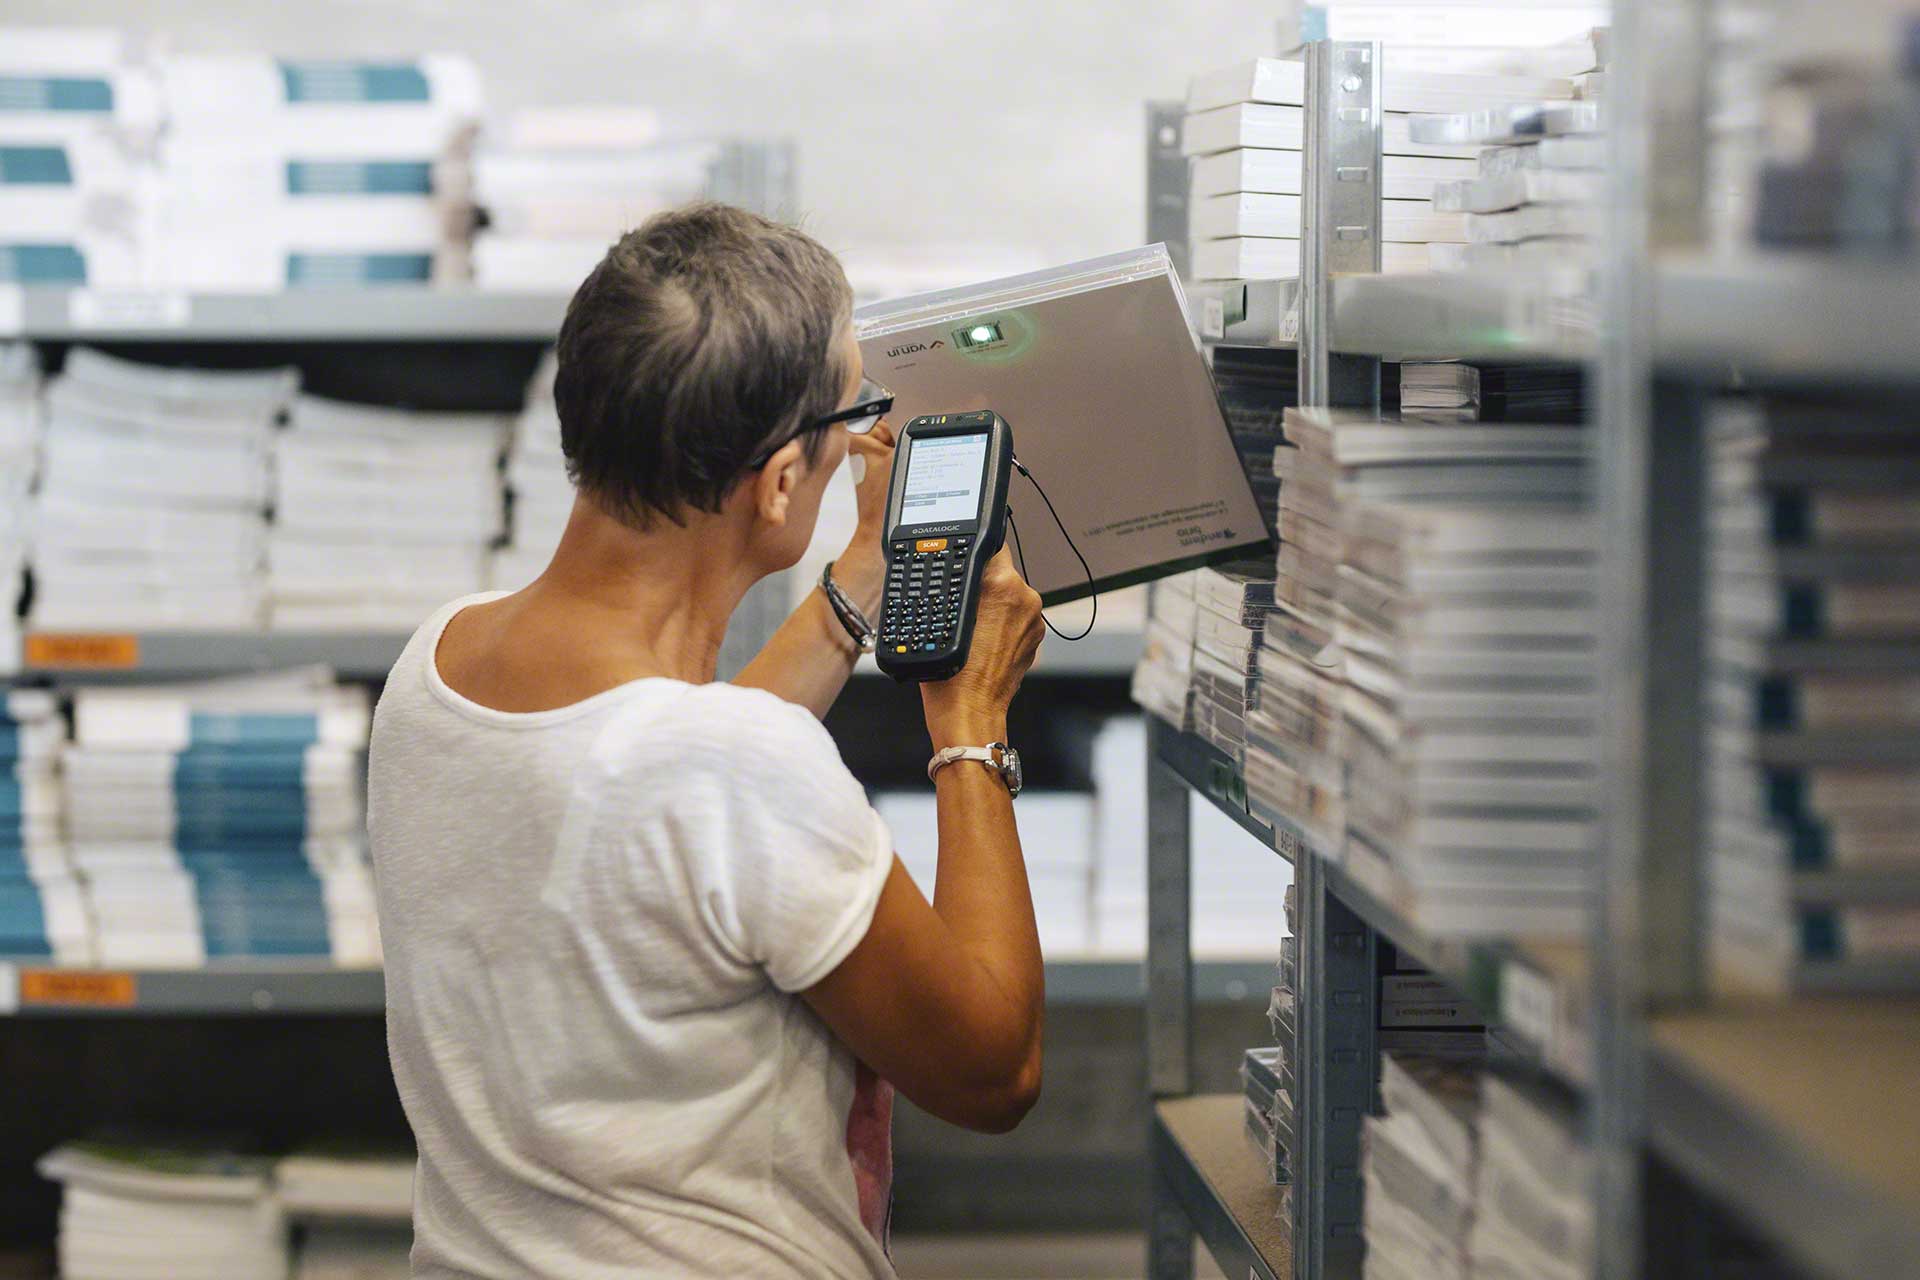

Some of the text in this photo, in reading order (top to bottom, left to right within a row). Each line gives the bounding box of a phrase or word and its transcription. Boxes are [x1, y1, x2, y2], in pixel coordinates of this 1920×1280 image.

[887, 343, 927, 358] van in
[918, 525, 960, 533] DATALOGIC
